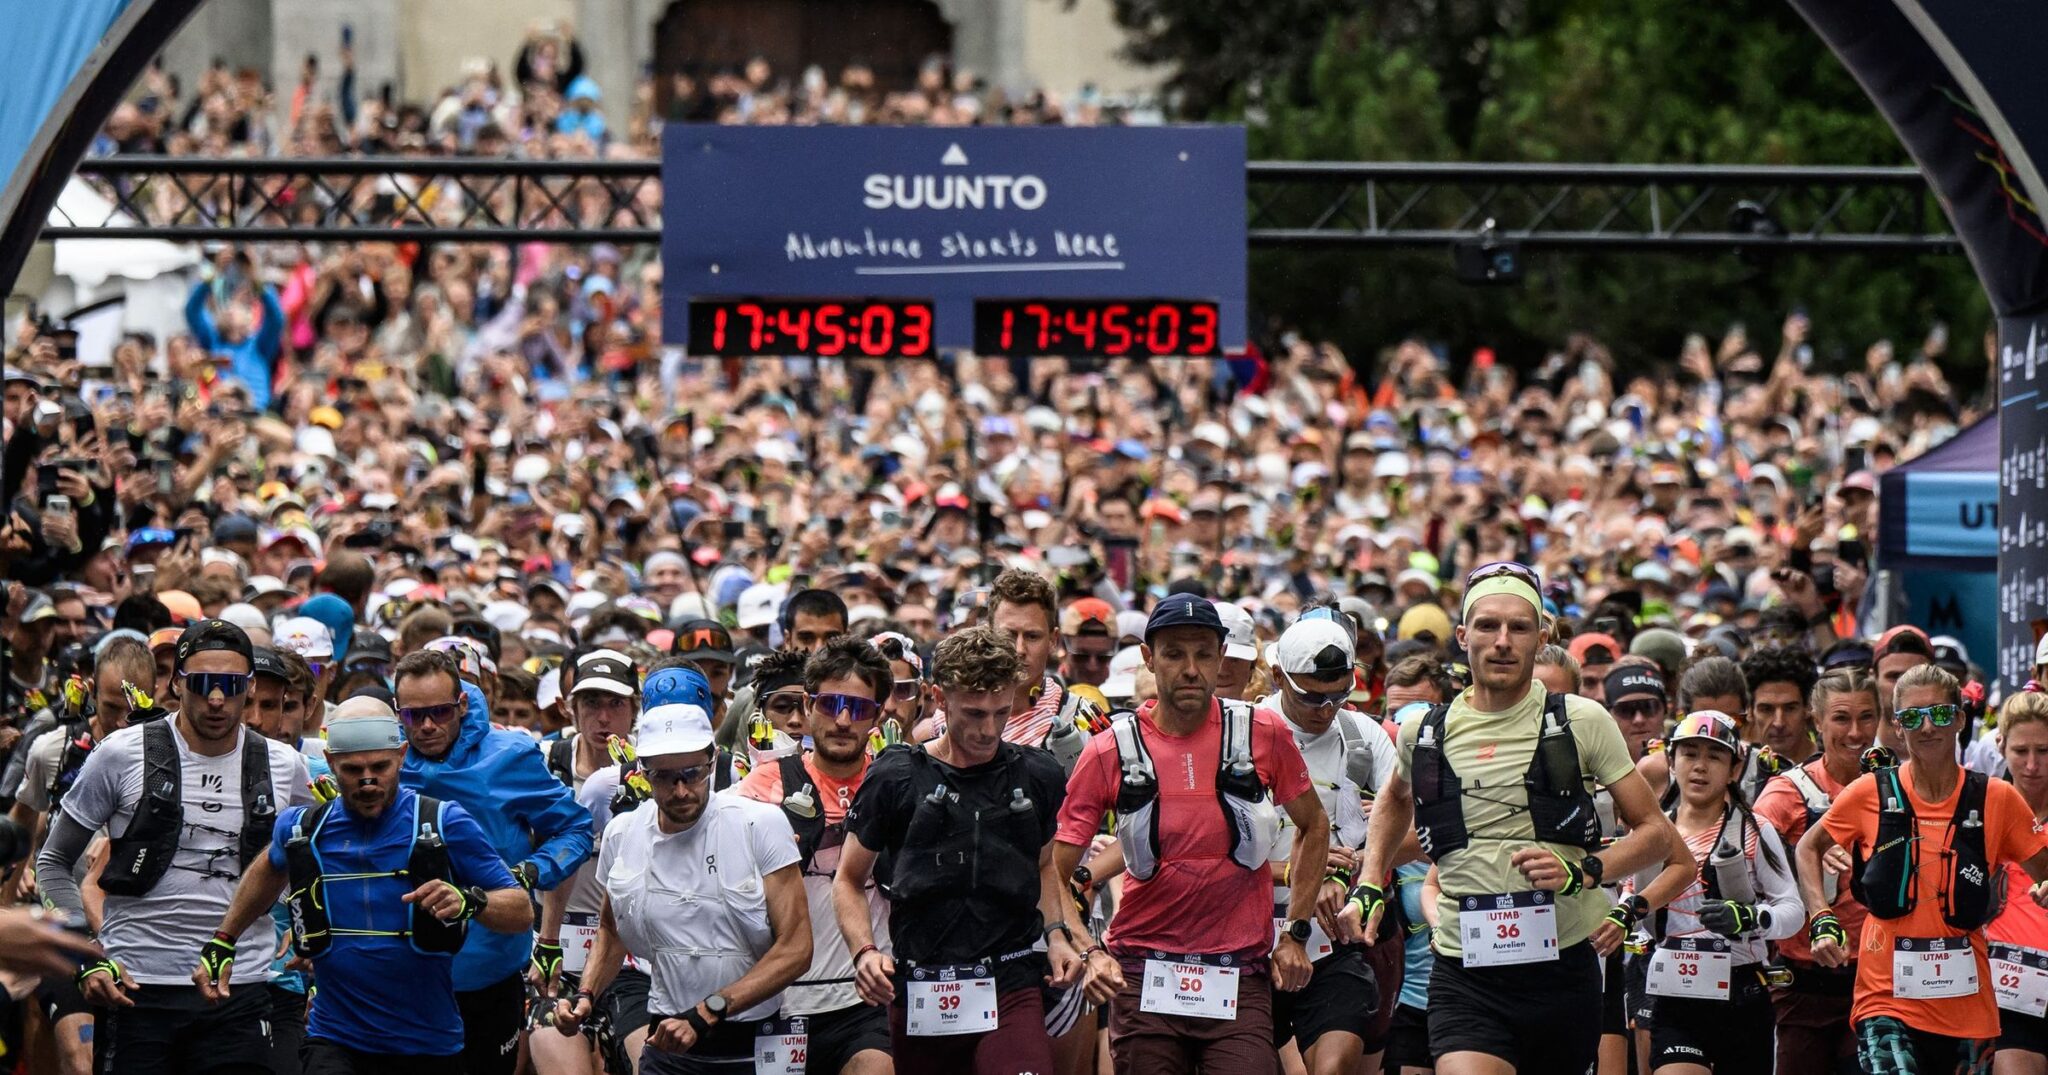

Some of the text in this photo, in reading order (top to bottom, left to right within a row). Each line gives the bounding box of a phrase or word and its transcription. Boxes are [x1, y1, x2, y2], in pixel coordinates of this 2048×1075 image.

[863, 174, 1047, 210] SUUNTO
[713, 304, 932, 356] 17:45:03
[999, 304, 1218, 355] 17:45:03
[254, 657, 270, 667] OKA
[132, 847, 148, 875] SILVA
[1959, 867, 1983, 887] Feed
[1968, 863, 1984, 881] The
[1490, 911, 1520, 921] UTMB
[291, 897, 311, 951] HOKA
[580, 928, 598, 936] UTM
[1496, 923, 1520, 939] 36
[1493, 941, 1526, 949] Aurelien
[1674, 953, 1700, 961] UTMB
[1923, 952, 1949, 961] UTMB
[1175, 964, 1205, 976] UTMB
[1678, 963, 1698, 977] 33
[1935, 964, 1941, 977] 1
[1998, 961, 2024, 974] UTMB
[933, 983, 961, 993] UTMB
[1179, 977, 1203, 993] 50
[1922, 979, 1954, 987] Courtney
[1999, 974, 2020, 989] 62
[938, 995, 961, 1011] 39
[1174, 993, 1205, 1003] Francois
[940, 1012, 958, 1021] Théo
[790, 1049, 806, 1064] 26
[1674, 1045, 1704, 1057] TERREX
